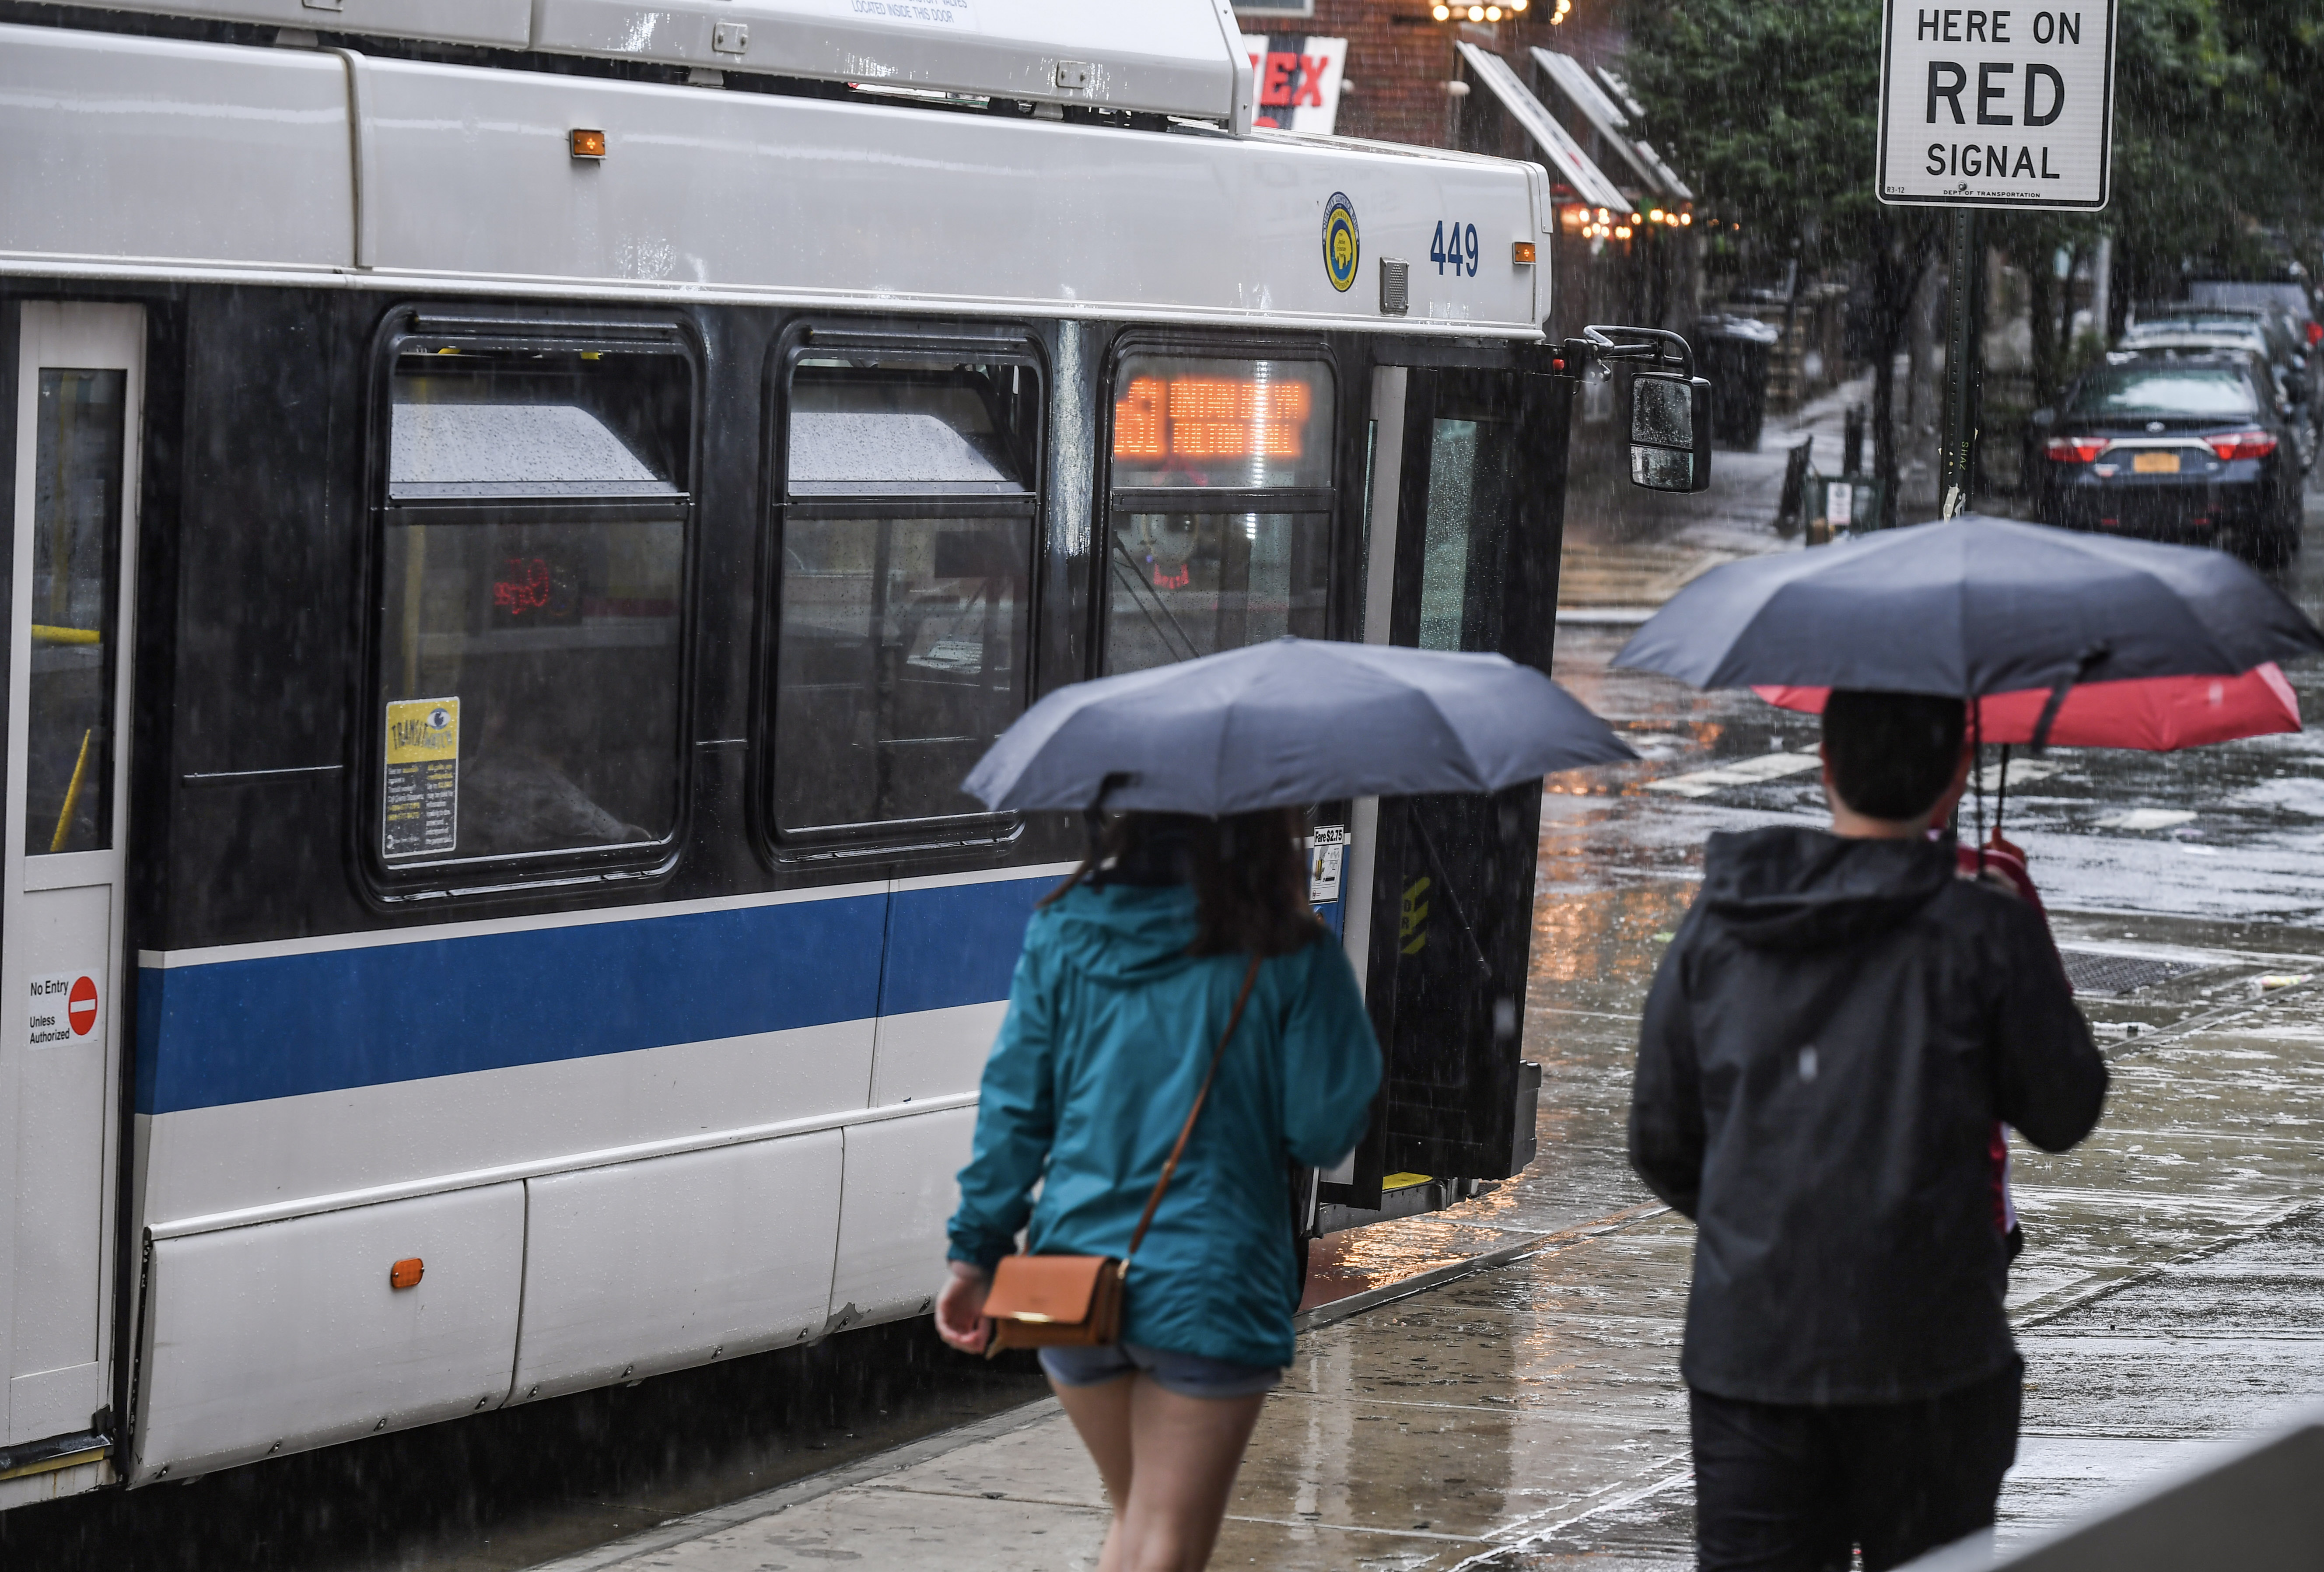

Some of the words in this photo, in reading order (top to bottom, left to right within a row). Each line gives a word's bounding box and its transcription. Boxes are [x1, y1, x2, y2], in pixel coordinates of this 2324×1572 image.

[851, 0, 886, 14] LOCATED
[886, 4, 912, 18] INSIDE
[912, 6, 930, 20] THIS
[931, 9, 954, 22] DOOR
[1918, 9, 2010, 42] HERE
[2033, 11, 2080, 44] ON
[1248, 52, 1329, 108] EX
[1926, 61, 2065, 126] RED
[1926, 144, 2060, 179] SIGNAL
[1430, 220, 1478, 277] 449
[1173, 423, 1243, 453] FULTON
[1959, 441, 1969, 470] SHAZ
[1315, 831, 1326, 843] Fare
[1326, 829, 1342, 843] $2.75
[30, 982, 43, 996] No
[45, 980, 69, 996] Entry
[29, 1015, 56, 1028] Unless
[29, 1027, 70, 1044] Authorized
